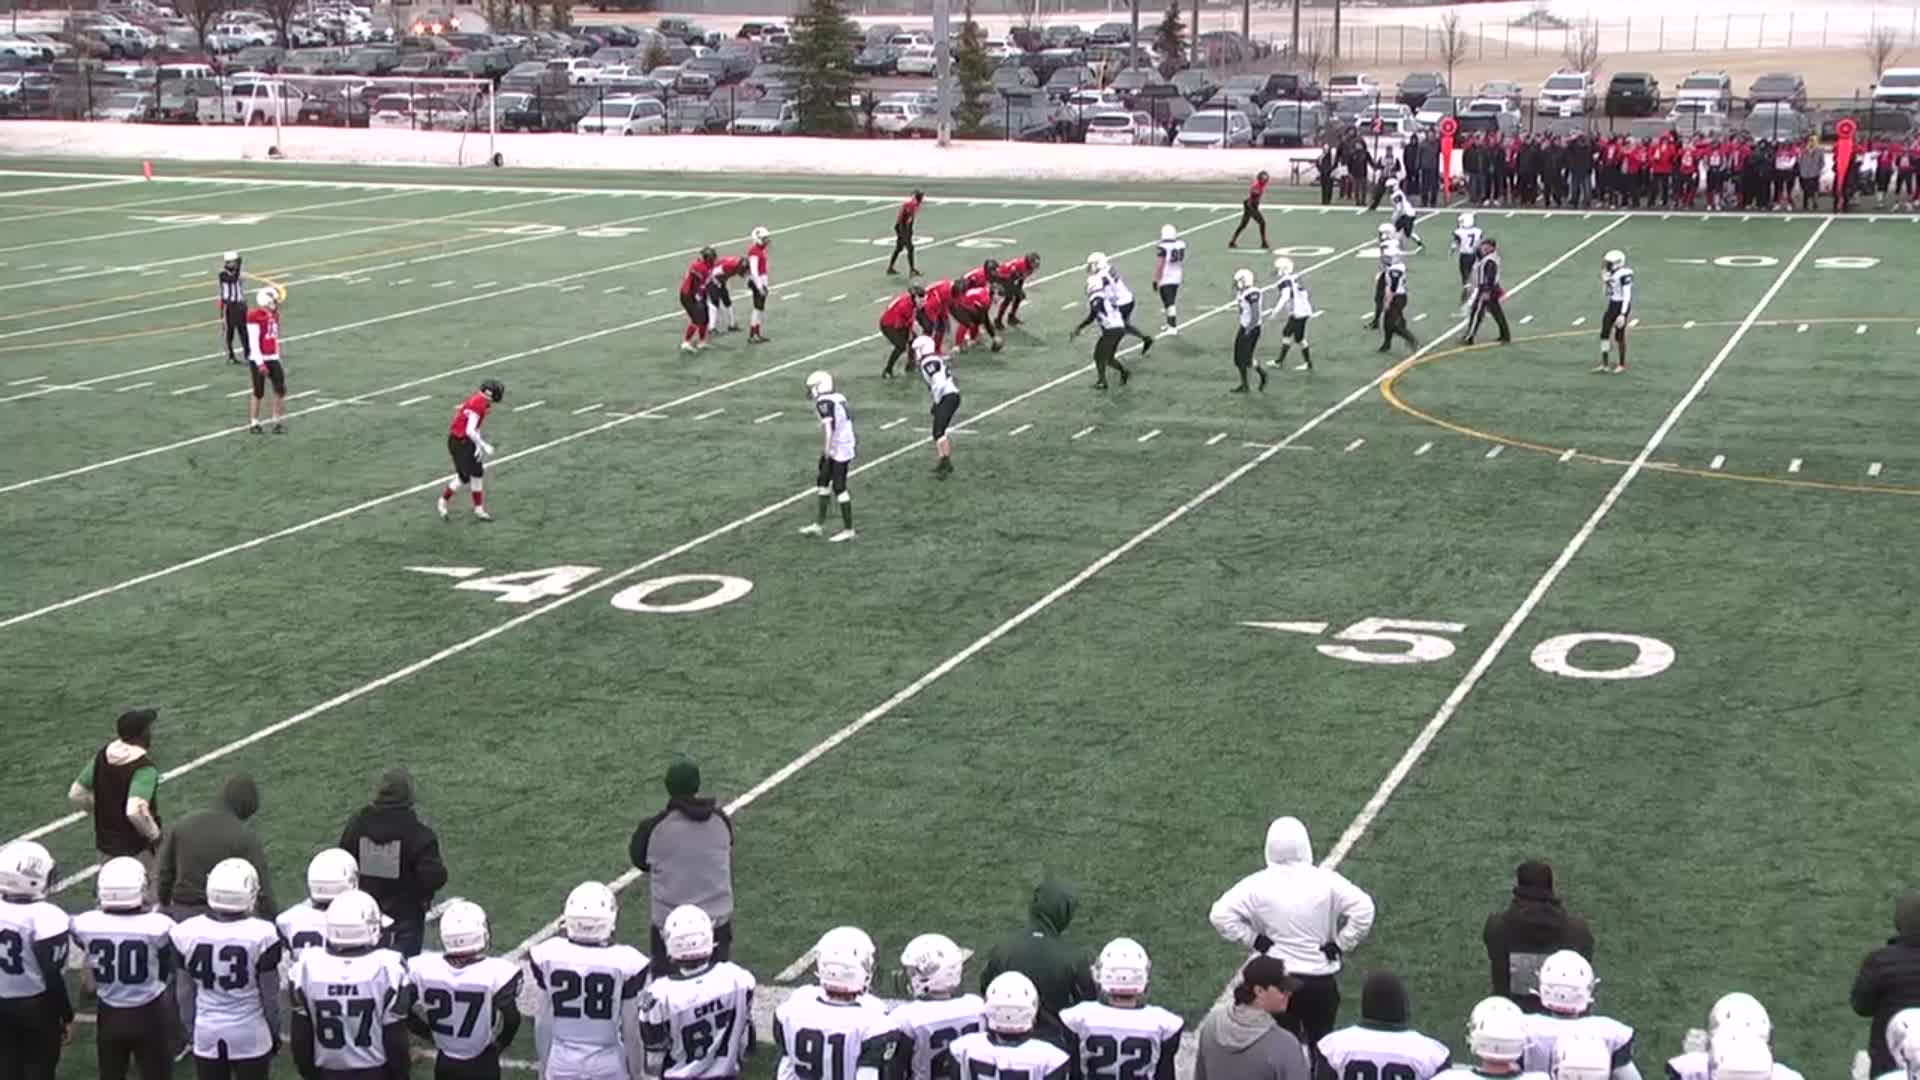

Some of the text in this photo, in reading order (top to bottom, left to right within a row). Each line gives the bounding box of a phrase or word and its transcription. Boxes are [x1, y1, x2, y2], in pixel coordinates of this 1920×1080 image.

[88, 938, 149, 984] 30
[188, 943, 248, 990] 43
[425, 988, 485, 1038] 27
[551, 969, 614, 1020] 28
[314, 998, 376, 1050] 67
[795, 1027, 846, 1080] 91
[1086, 1034, 1153, 1080] 22
